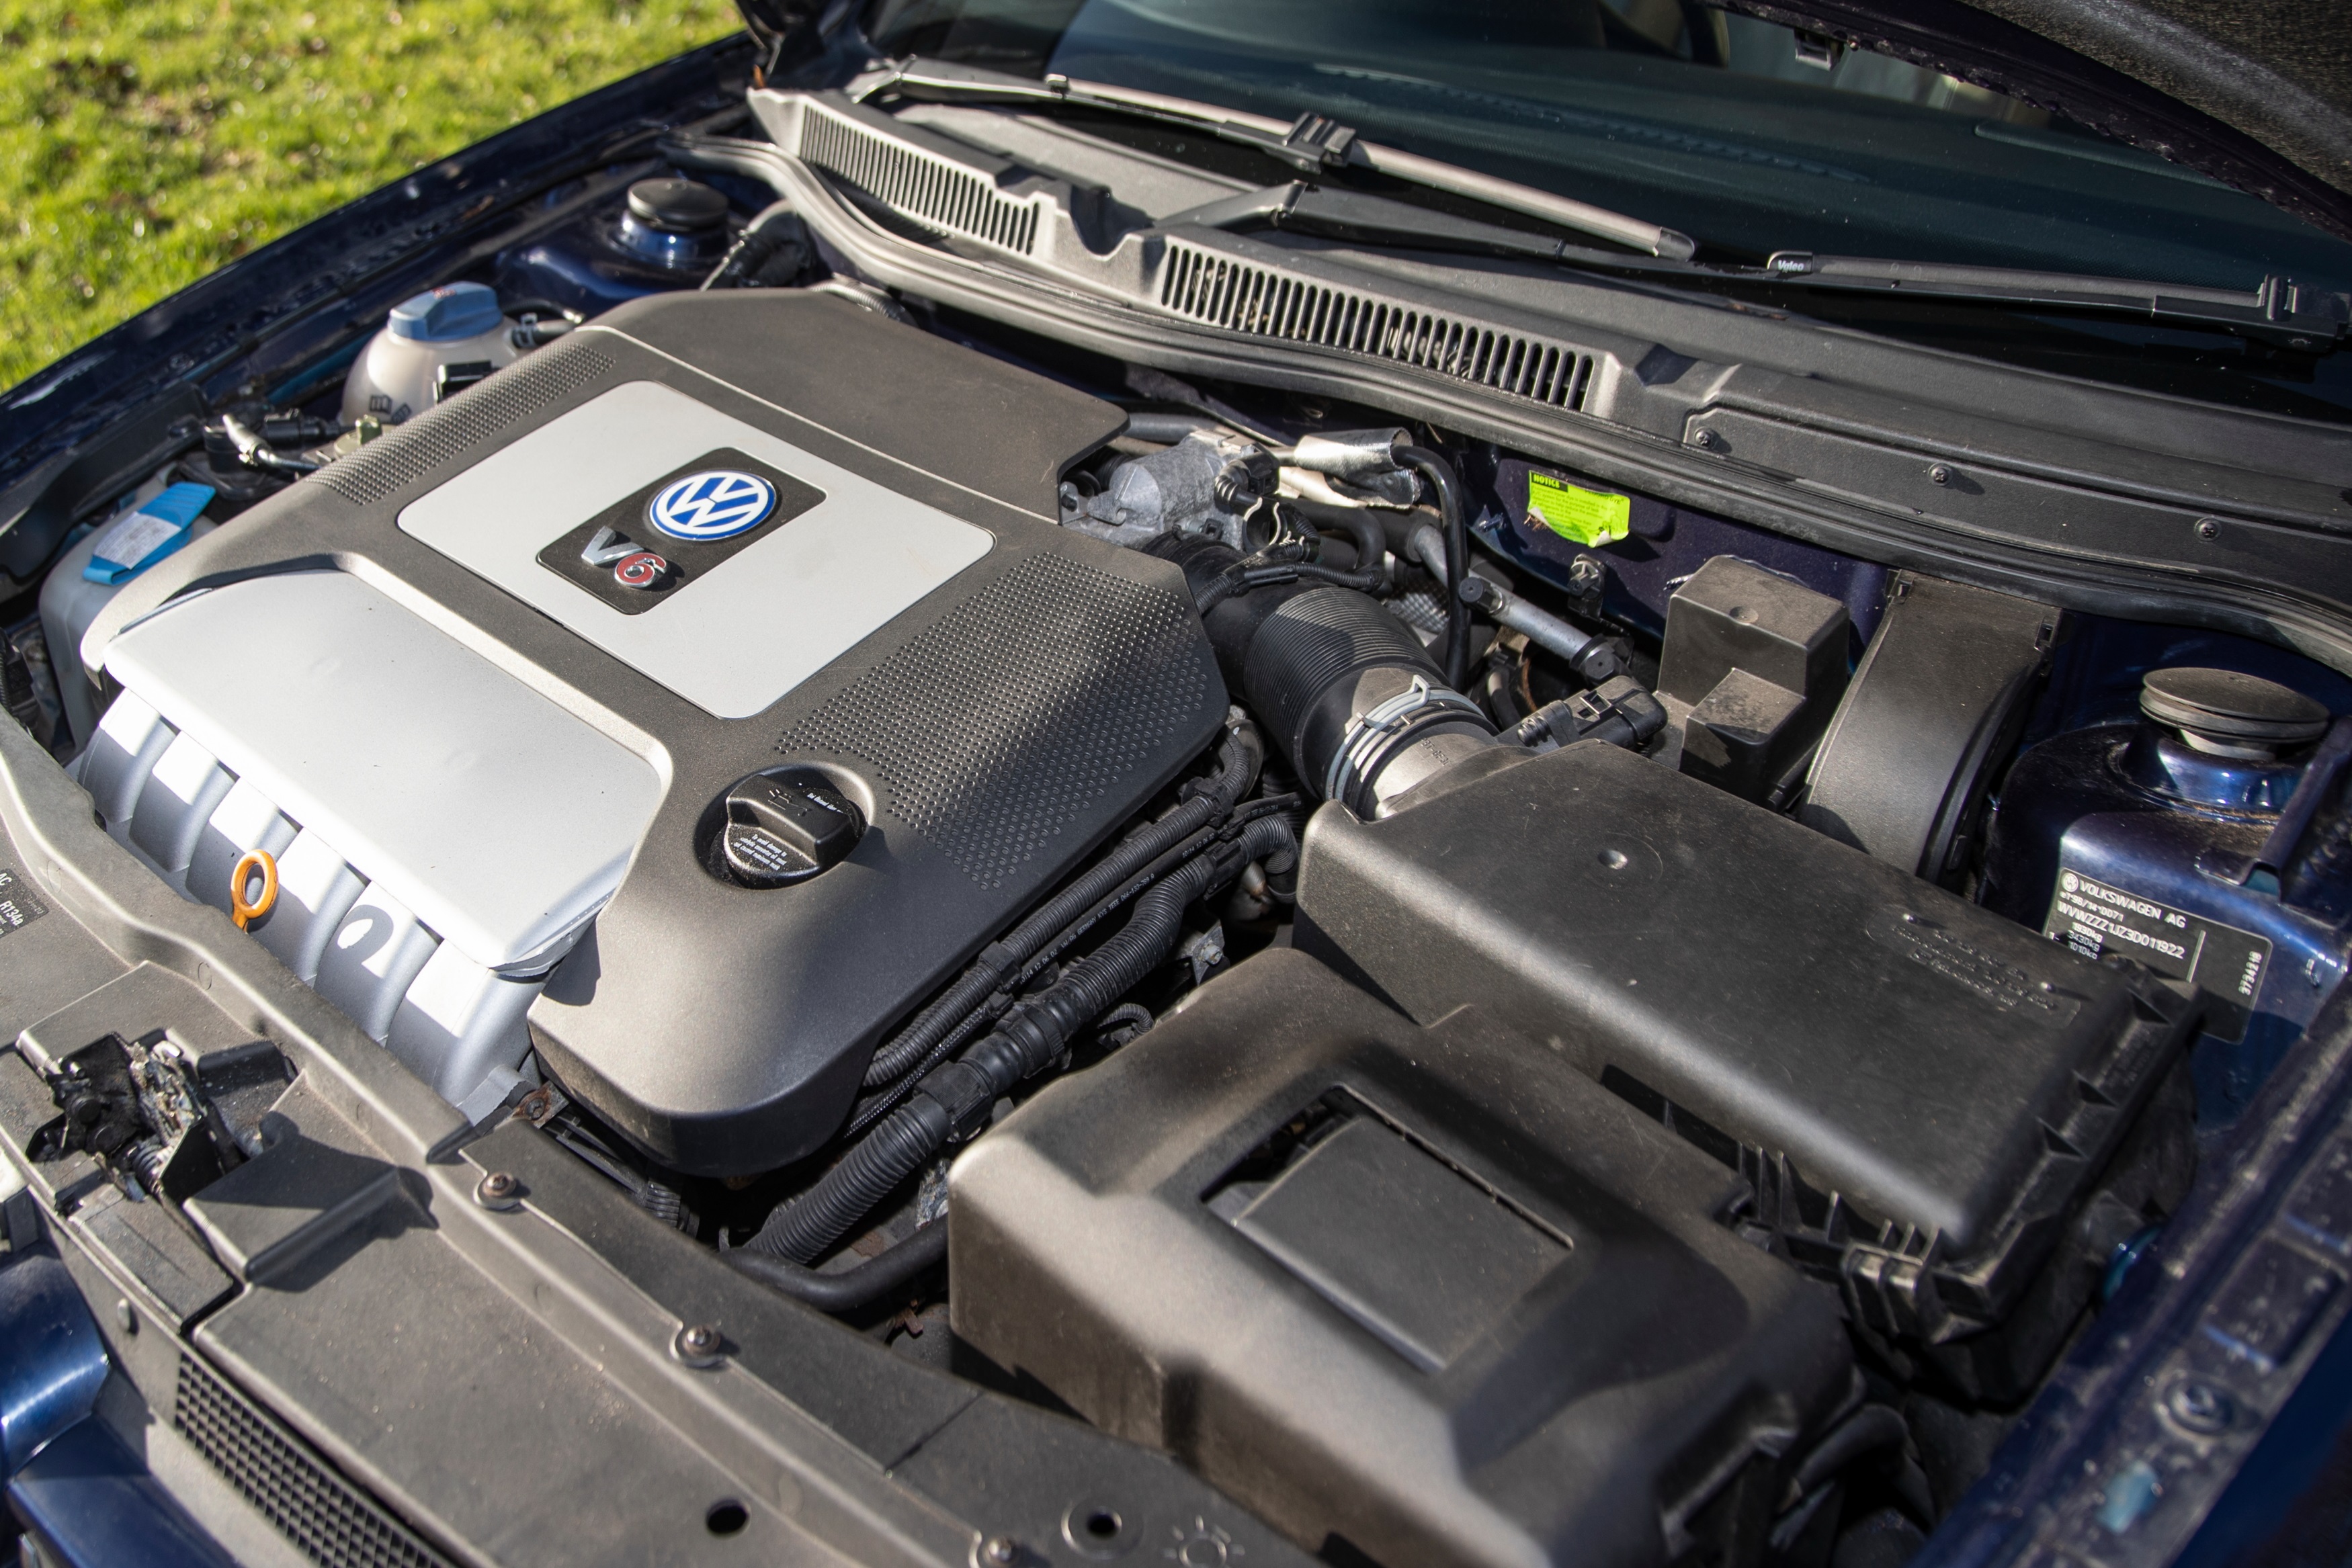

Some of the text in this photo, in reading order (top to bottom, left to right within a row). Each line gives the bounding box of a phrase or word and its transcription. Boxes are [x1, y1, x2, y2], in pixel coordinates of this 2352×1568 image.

[1777, 260, 1804, 271] Valeo
[1534, 474, 1560, 488] NOTICE
[653, 472, 769, 537] VW
[581, 525, 667, 588] V6
[0, 900, 24, 926] R134a
[2080, 880, 2161, 920] VOLKSWAGEN
[2165, 913, 2186, 928] AG
[2068, 930, 2100, 952] 3430kg
[2072, 922, 2103, 943] 1930kg
